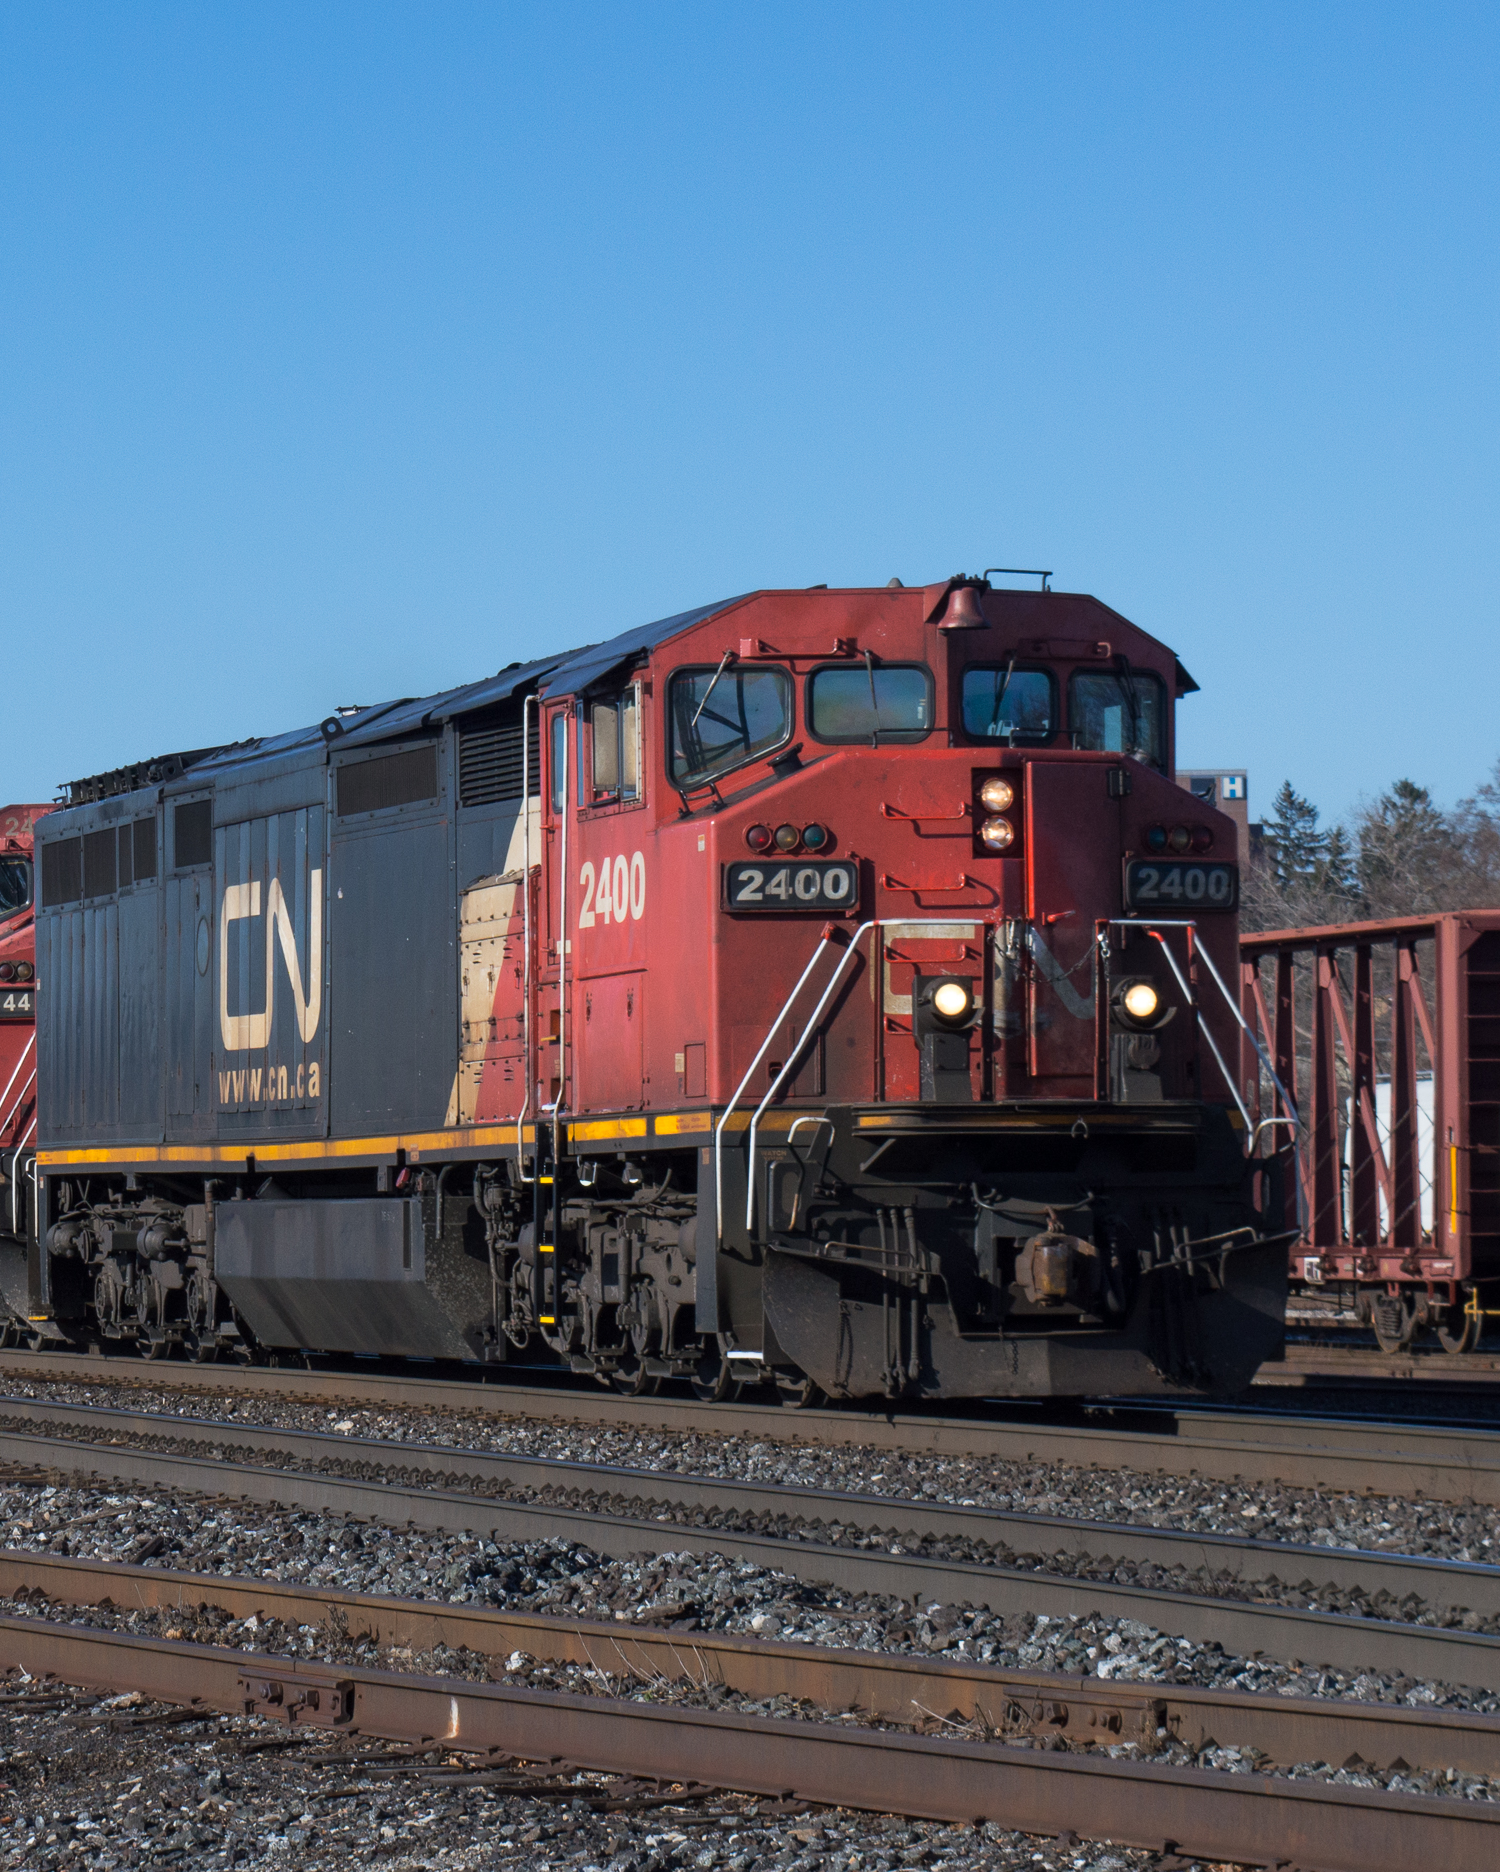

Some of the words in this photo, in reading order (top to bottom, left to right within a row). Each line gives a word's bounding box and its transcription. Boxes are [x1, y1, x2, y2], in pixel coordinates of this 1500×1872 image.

[1223, 777, 1243, 798] H
[5, 817, 34, 836] 24
[579, 851, 646, 929] 2400
[736, 868, 850, 901] 2400
[1136, 867, 1230, 900] 2400
[220, 868, 322, 1051] CN
[218, 1061, 321, 1104] www.cn.ca
